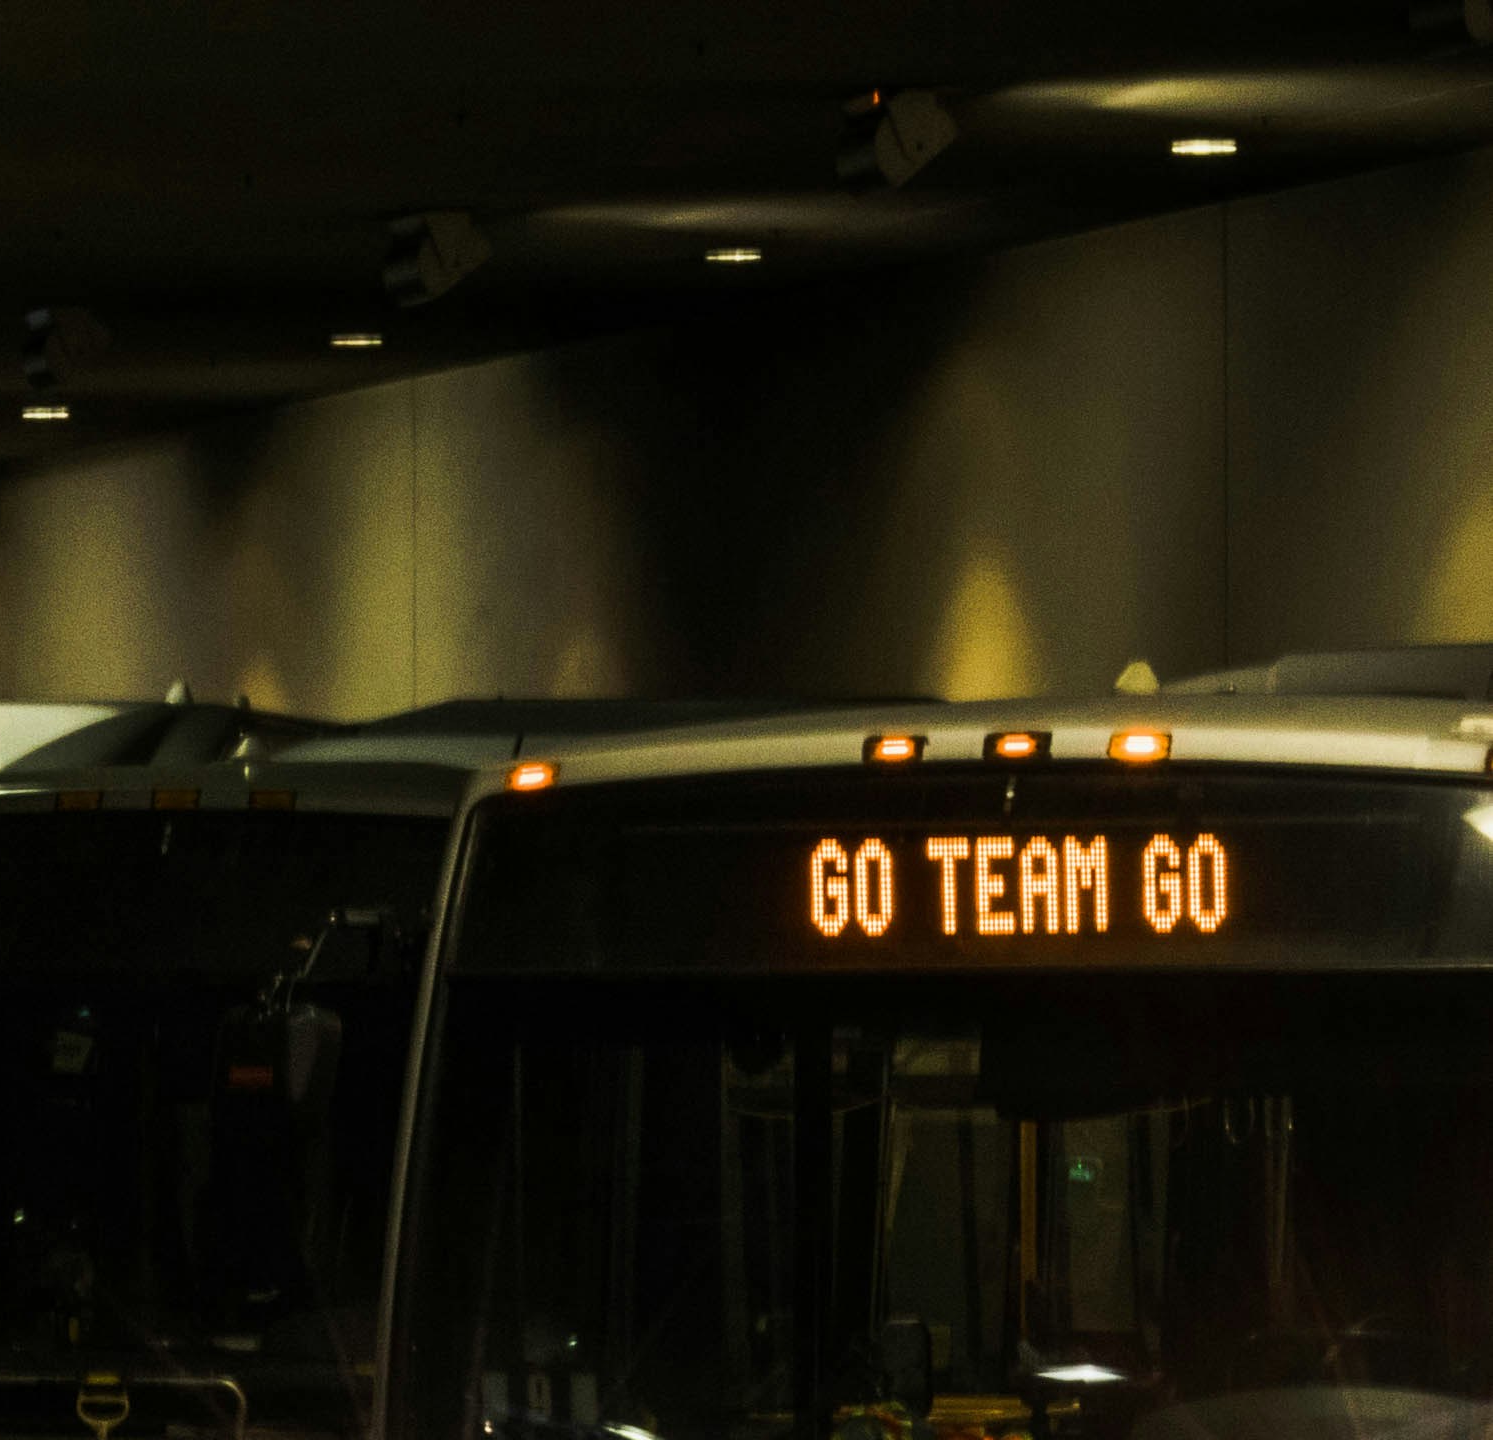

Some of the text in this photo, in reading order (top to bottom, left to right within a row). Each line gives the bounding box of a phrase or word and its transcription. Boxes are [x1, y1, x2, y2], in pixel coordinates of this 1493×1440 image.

[811, 833, 1227, 937] GO TEAM GO
